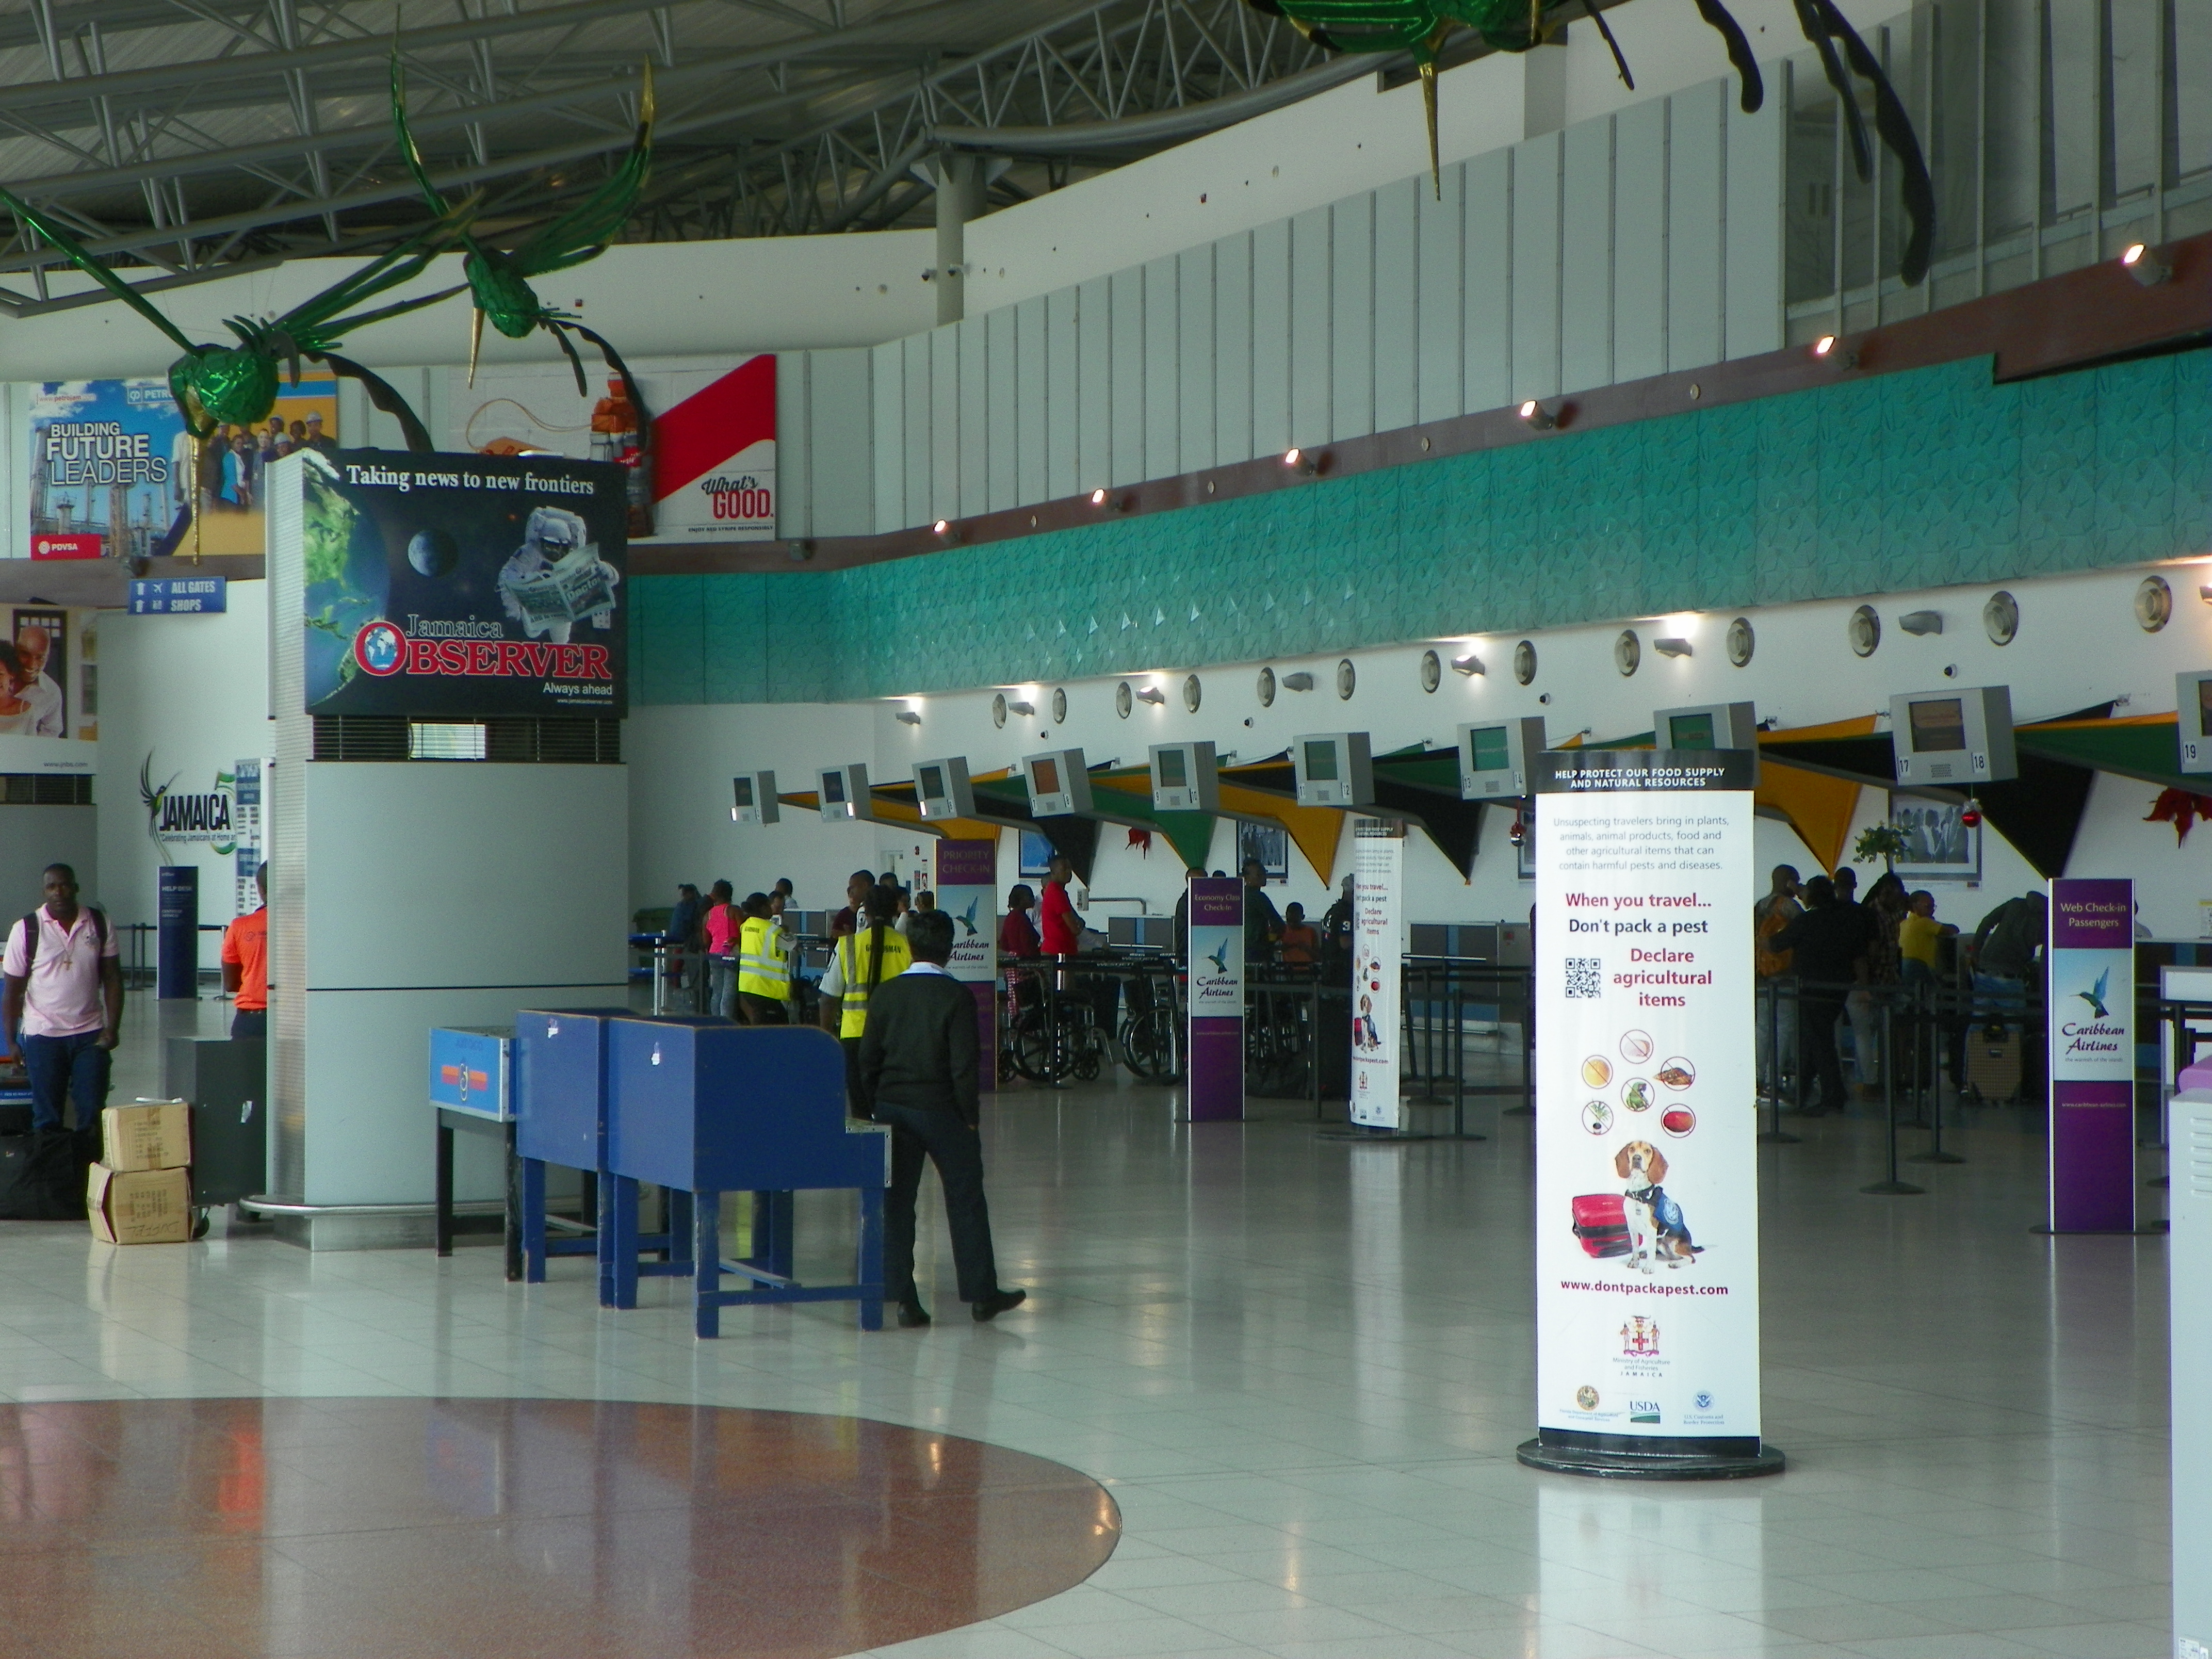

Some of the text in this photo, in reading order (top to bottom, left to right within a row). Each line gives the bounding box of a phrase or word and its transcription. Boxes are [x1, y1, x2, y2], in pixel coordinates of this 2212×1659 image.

[51, 421, 121, 437] BUILDING
[46, 433, 150, 461] FUTURE
[51, 457, 168, 485] LEADERS
[346, 464, 594, 495] Taking news to new frontiers
[701, 476, 759, 495] What's
[51, 543, 78, 551] PDVSA
[171, 580, 216, 594] ALL GATES
[170, 599, 201, 612] SHOPS
[405, 614, 503, 638] Jamaica
[354, 620, 612, 679] OBSERVER
[543, 682, 612, 696] Always ahead
[2185, 744, 2196, 759] 19
[1900, 759, 1908, 773] 17
[1975, 756, 1984, 769] 18
[1555, 767, 1725, 779] HELP PROTECT OUR FOOD SUPPLY
[1571, 777, 1706, 789] AND NATURAL RESOURCES
[1343, 785, 1349, 795] 12
[159, 794, 231, 831] JAMAICA
[1554, 815, 1729, 828] Unsuspecting travelers bring in plants,
[1560, 830, 1721, 842] animals, animal products, food and
[944, 851, 989, 859] PRIORITY
[1566, 846, 1588, 855] other
[1591, 845, 1642, 857] agricultural
[1645, 845, 1671, 855] items
[1674, 845, 1694, 855] that
[942, 864, 989, 873] CHECK-IN
[1559, 860, 1723, 872] contain harmful pests and diseases.
[1566, 892, 1712, 910] When you travel...
[2060, 902, 2126, 913] Web Check-in
[1342, 921, 1351, 931] 3
[1362, 918, 1388, 926] agricultural
[1569, 918, 1709, 937] Don't pack a pest
[2069, 917, 2119, 929] Passengers
[953, 939, 989, 949] aribbean
[950, 950, 984, 961] Airlines
[1631, 948, 1695, 963] Declare
[1197, 977, 1238, 986] Caribbean
[1613, 970, 1712, 988] agricultural
[1199, 987, 1233, 999] Airlines
[1639, 992, 1686, 1006] items
[2062, 1022, 2124, 1036] Caribbean
[2065, 1037, 2118, 1054] Airlines
[1560, 1280, 1729, 1297] www.dontpackapest.com
[1613, 1357, 1633, 1365] Ministry
[1630, 1401, 1661, 1412] USDA
